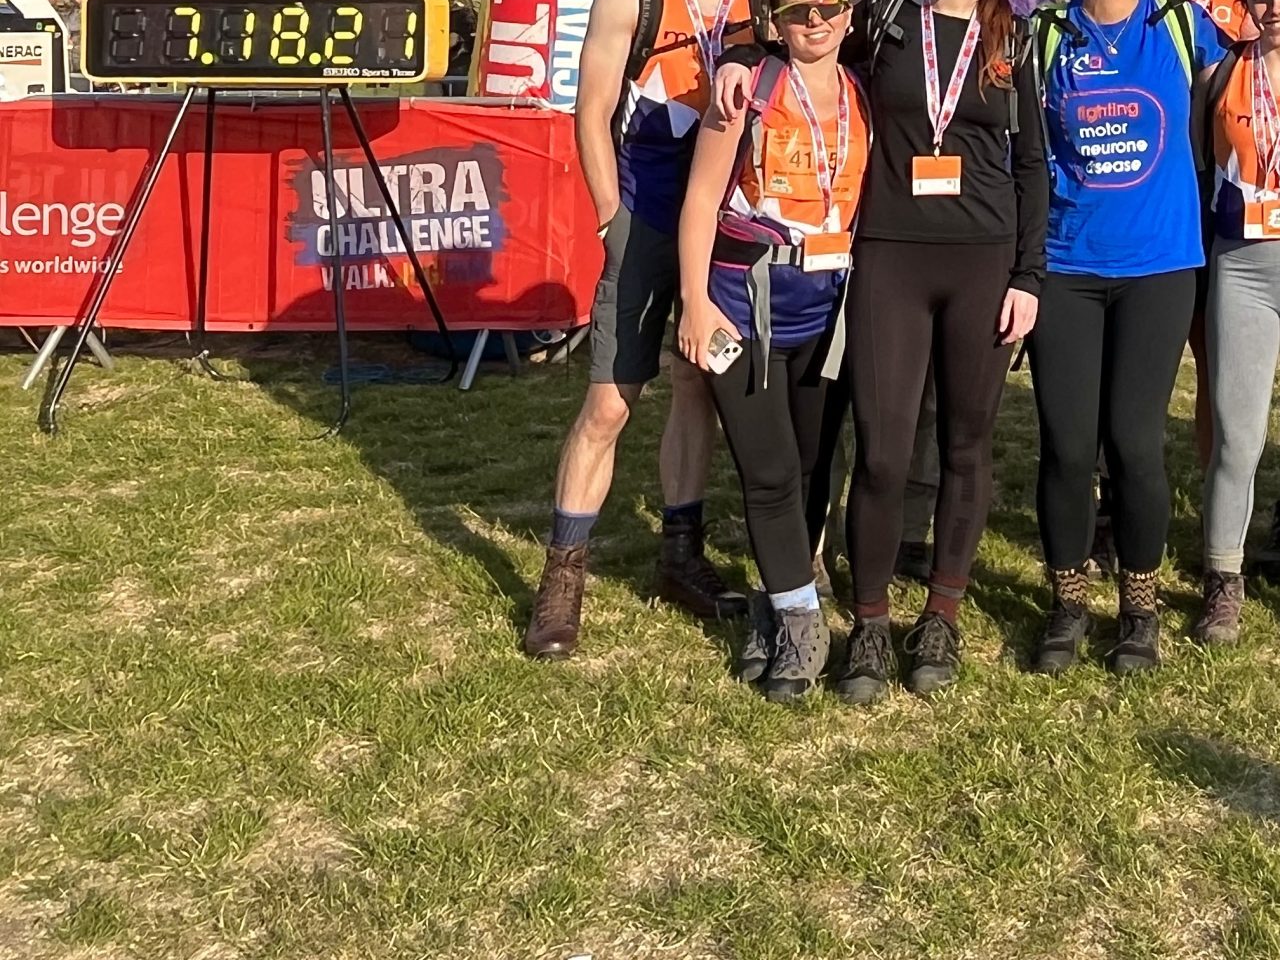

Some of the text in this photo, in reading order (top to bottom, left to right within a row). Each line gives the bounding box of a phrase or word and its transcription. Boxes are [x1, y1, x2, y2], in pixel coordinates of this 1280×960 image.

[322, 67, 360, 77] SEIKO
[361, 68, 390, 77] Sports
[1077, 102, 1139, 123] fighting
[1079, 122, 1128, 139] motor
[1080, 139, 1148, 157] neurone
[1085, 158, 1142, 175] dsease
[311, 160, 492, 221] ULTRA
